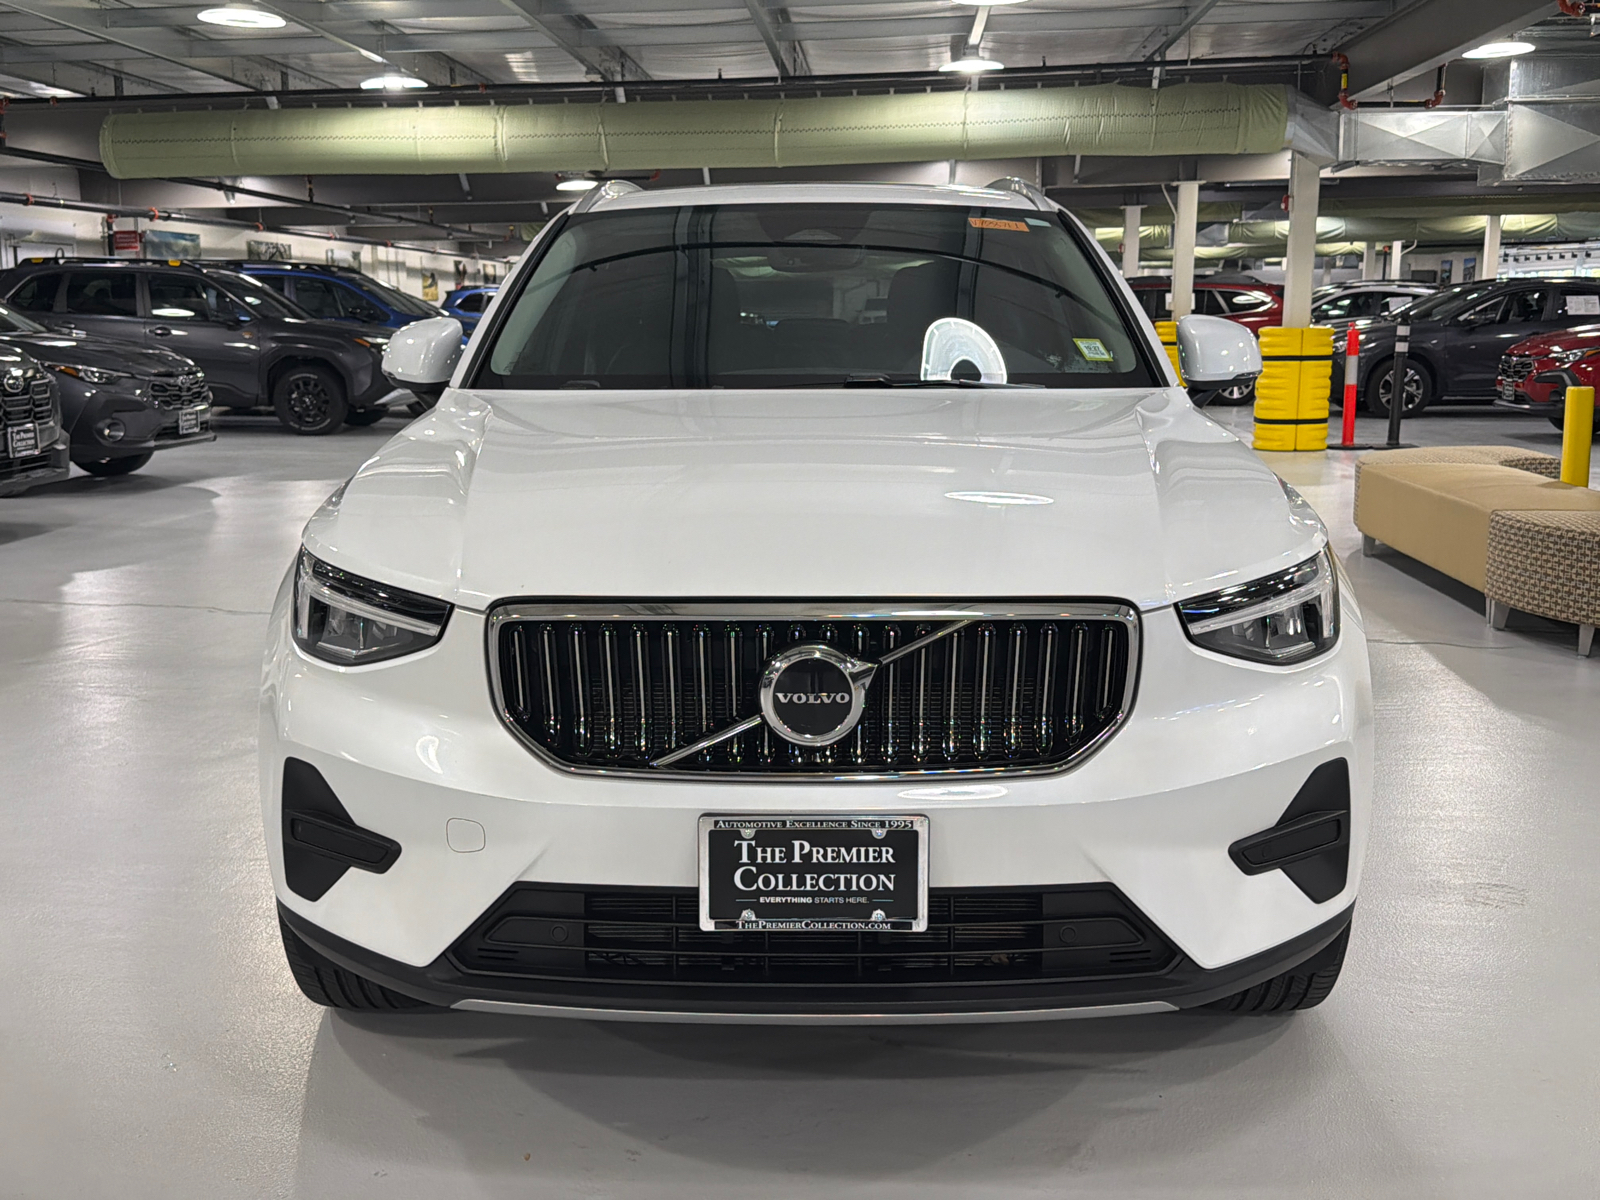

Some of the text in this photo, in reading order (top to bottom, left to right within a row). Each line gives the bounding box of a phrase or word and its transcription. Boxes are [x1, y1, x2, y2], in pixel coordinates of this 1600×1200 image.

[775, 692, 850, 704] VOLVO
[716, 820, 912, 829] AUTOMOTIVE EXCELLENCE SINCE 1995
[733, 839, 896, 864] THE PREMIER
[733, 865, 896, 892] COLLECTION
[759, 896, 870, 904] EVERYTHING STARTS HERE.
